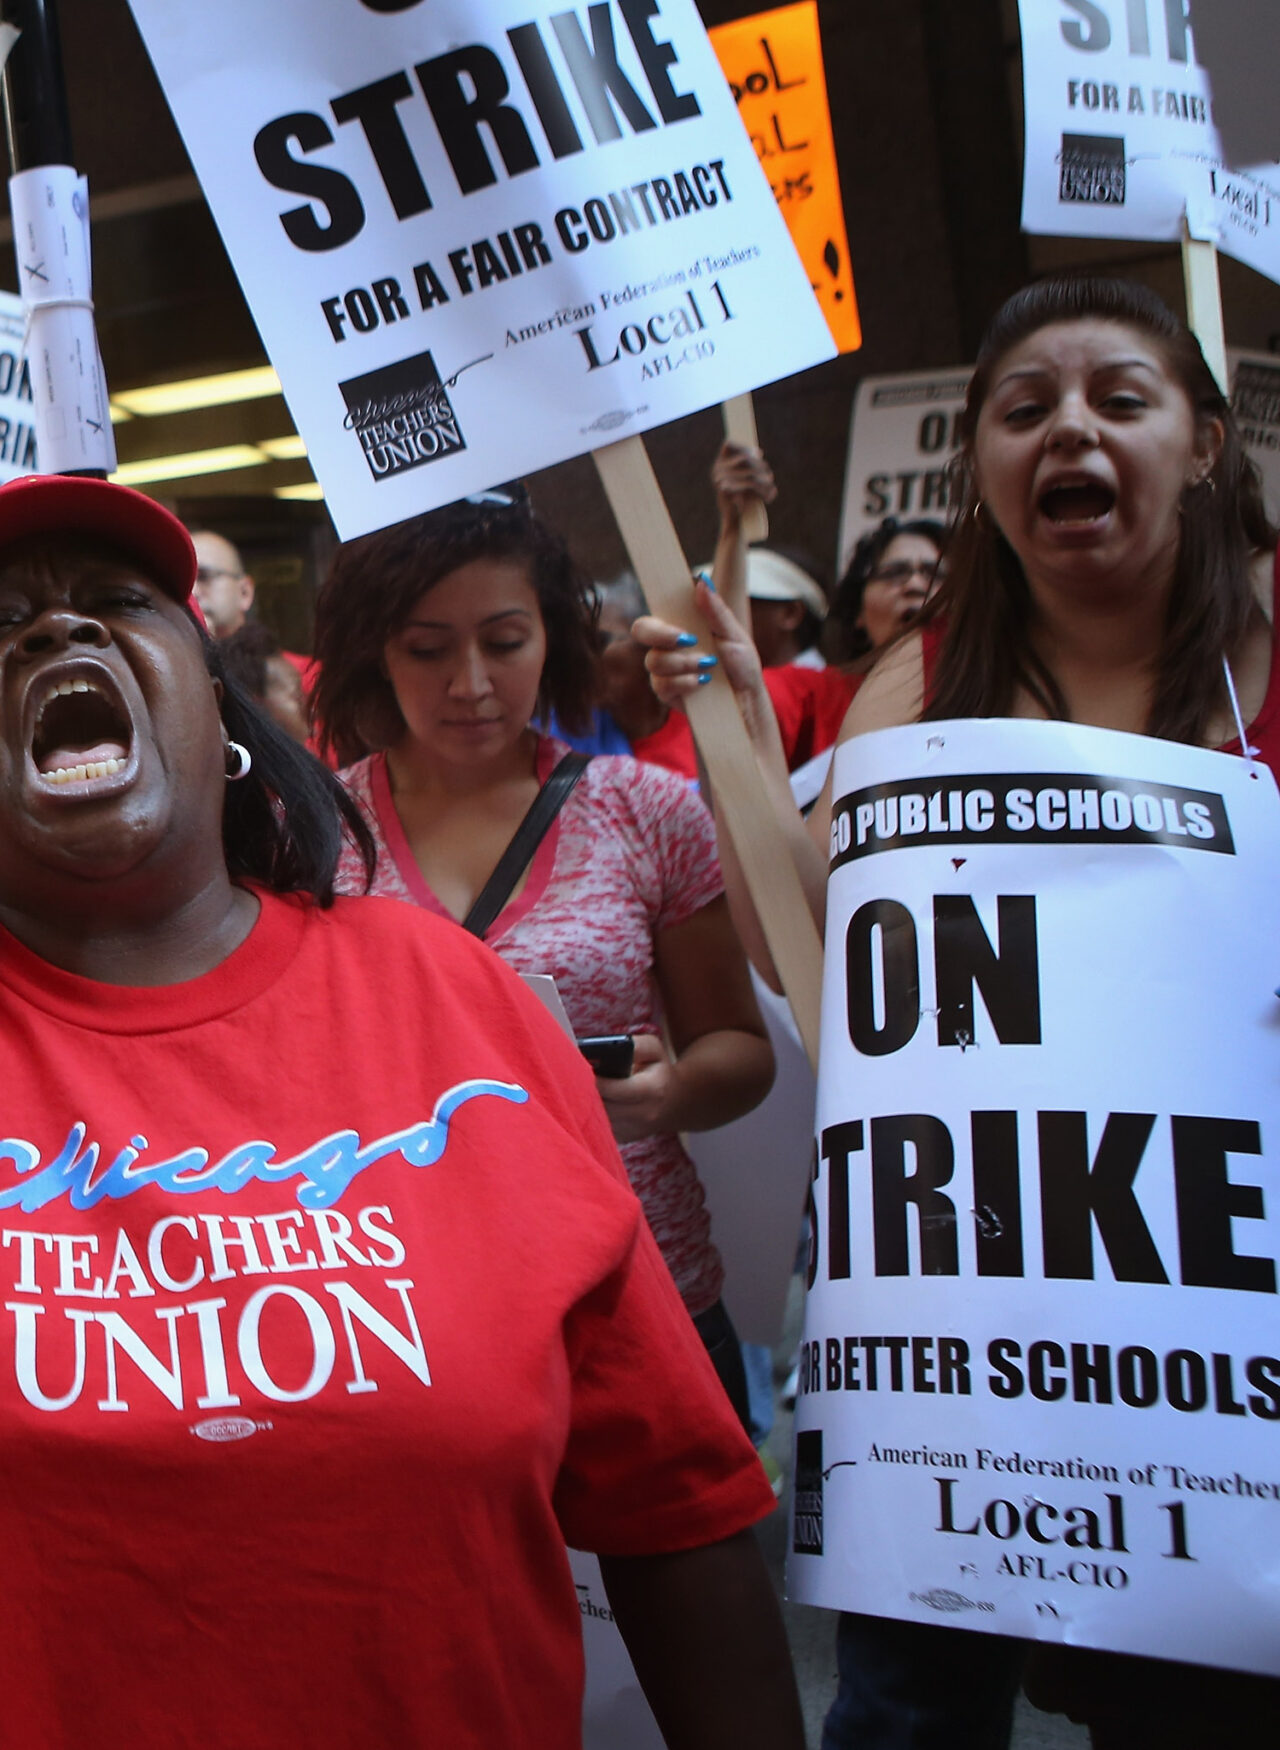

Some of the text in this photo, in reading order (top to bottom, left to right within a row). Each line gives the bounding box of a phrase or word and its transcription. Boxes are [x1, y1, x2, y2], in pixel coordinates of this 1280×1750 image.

[254, 0, 704, 253] STRIKE
[1067, 79, 1207, 124] FOR A FAIR
[322, 160, 735, 343] FOR A FAIR CONTRACT
[504, 303, 597, 349] American
[600, 271, 687, 311] Federation
[687, 259, 702, 281] of
[702, 242, 762, 273] Teachers
[573, 280, 738, 374] Local 1
[640, 340, 717, 382] AFL-CIO
[357, 400, 456, 450] TEACHERS
[365, 421, 465, 475] UNION
[855, 789, 996, 847] PUBLIC
[1006, 787, 1217, 841] SCHOOLS
[846, 894, 1043, 1058] ON
[2, 1205, 407, 1300] TEACHERS
[4, 1278, 432, 1412] UNION
[825, 1335, 972, 1396] BETTER
[987, 1338, 1280, 1421] SCHOOLS
[867, 1442, 969, 1469] American
[974, 1448, 1120, 1484] Federation
[1128, 1462, 1159, 1487] of
[933, 1476, 1199, 1562] Local 1
[996, 1554, 1131, 1591] AFL-CIO
